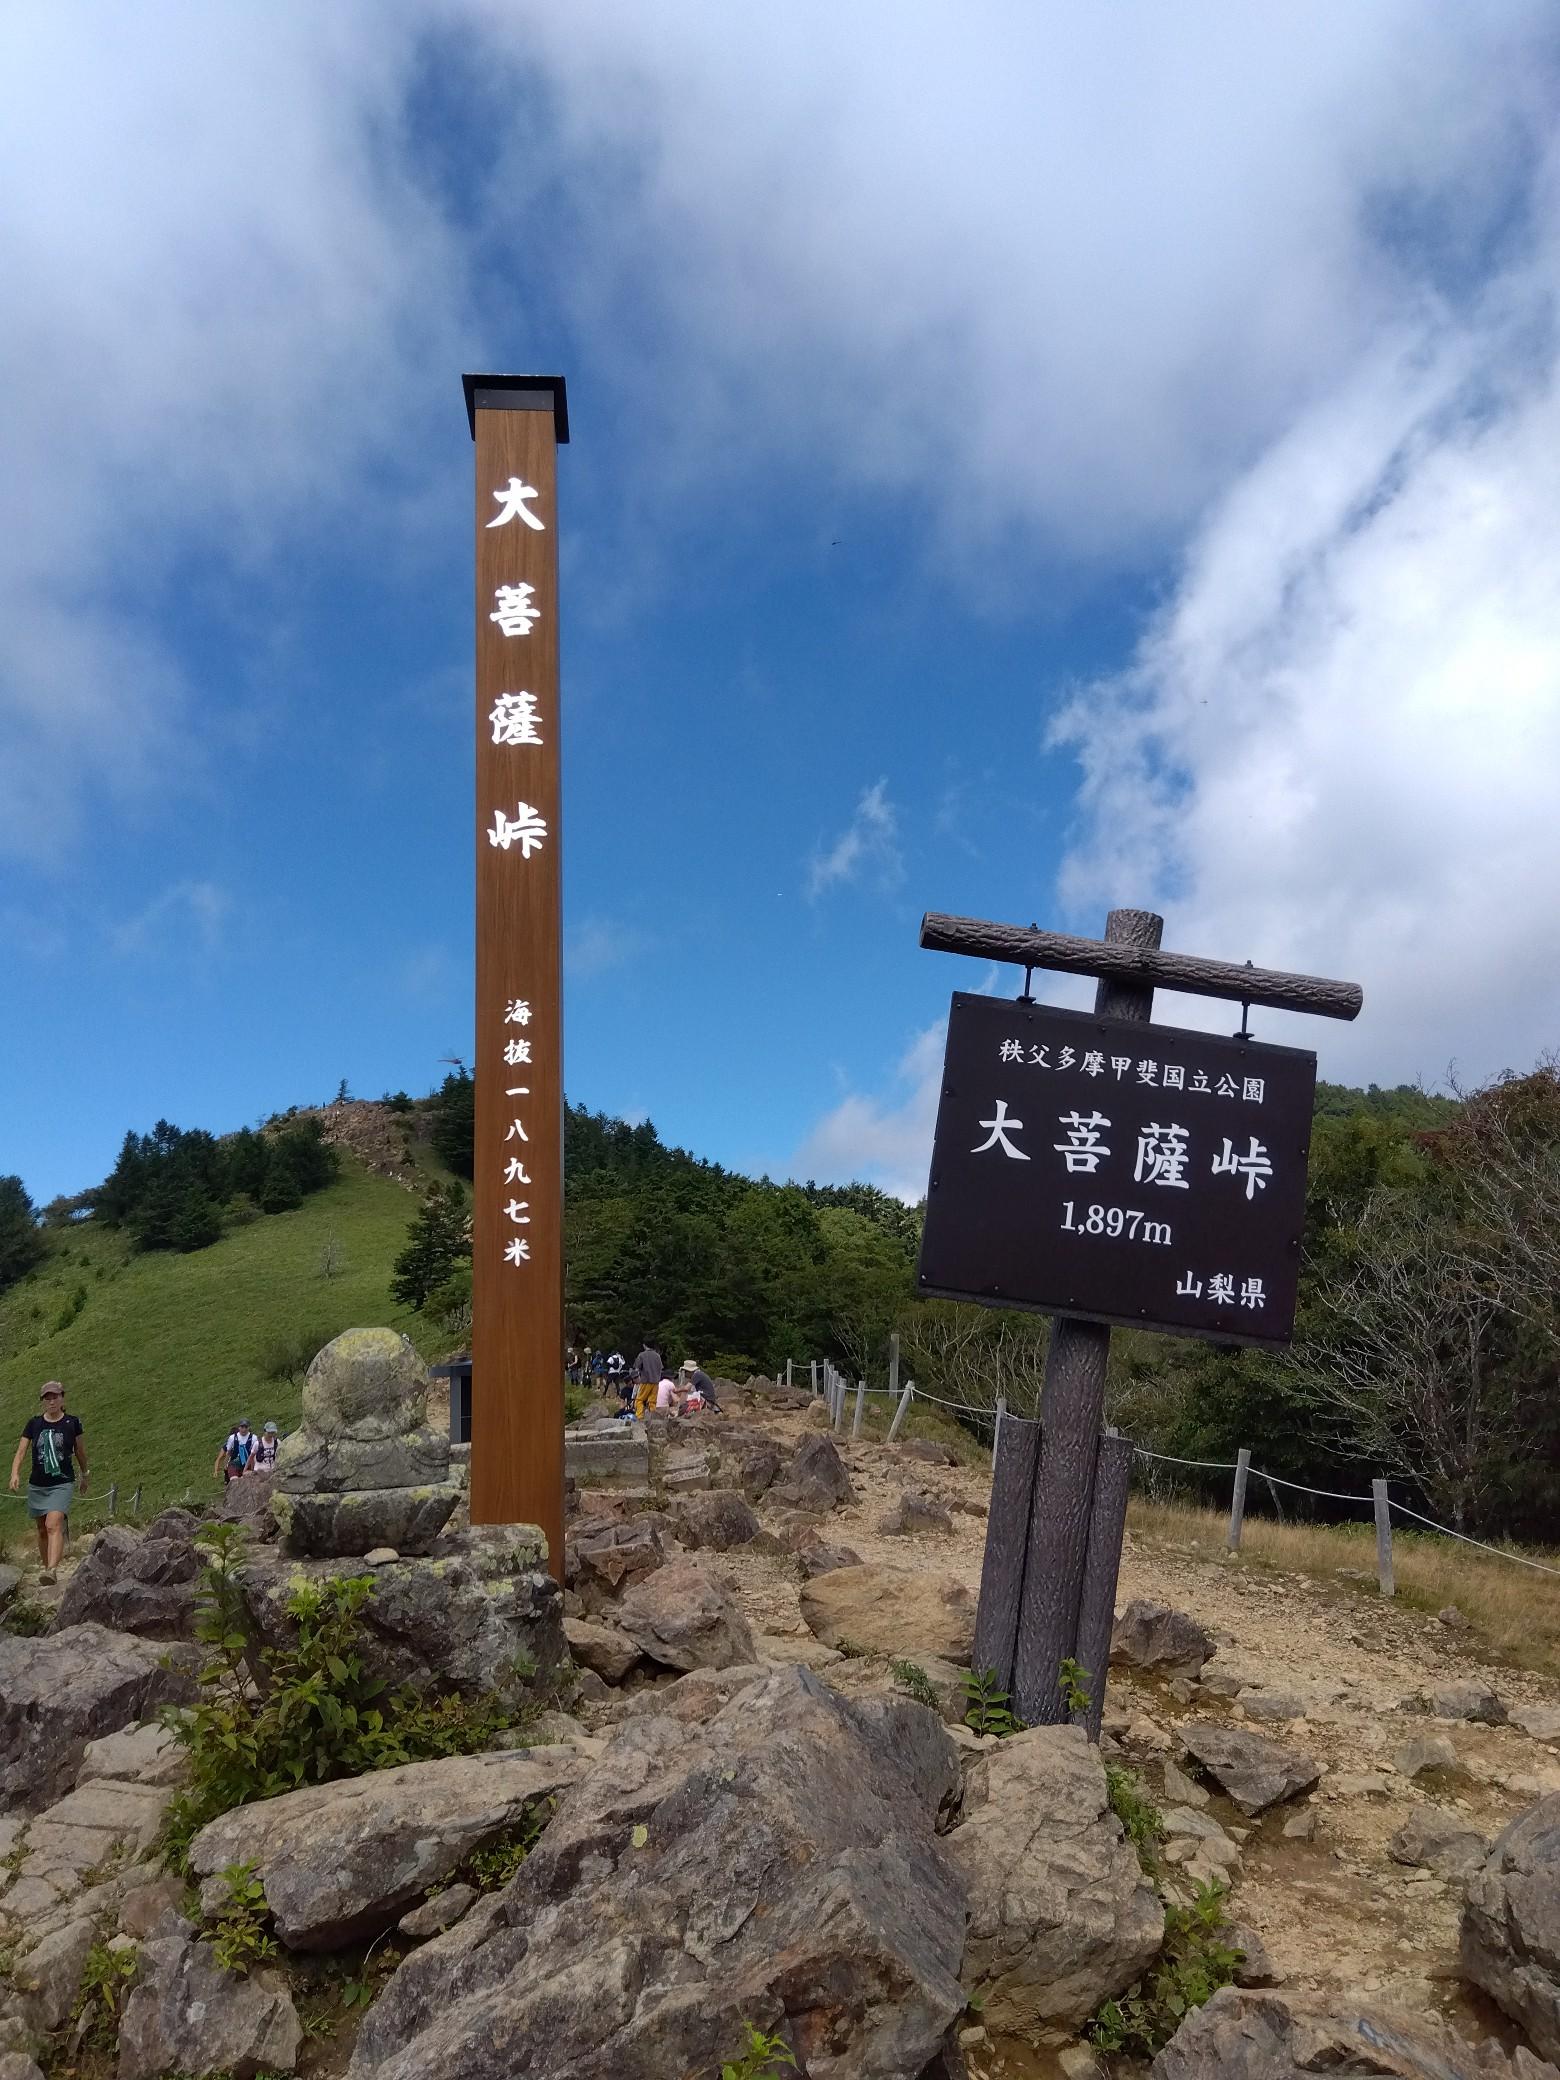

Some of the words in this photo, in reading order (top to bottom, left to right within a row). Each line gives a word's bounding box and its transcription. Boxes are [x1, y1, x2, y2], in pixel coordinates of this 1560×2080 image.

[484, 476, 548, 860] 大菩薩峠
[998, 1038, 1266, 1105] 秩父多摩甲斐国立公園
[503, 999, 533, 1268] 海抜一八九七米
[970, 1099, 1274, 1201] 大菩薩峠
[1060, 1201, 1172, 1246] 1,897m
[1176, 1270, 1267, 1310] 山梨県
